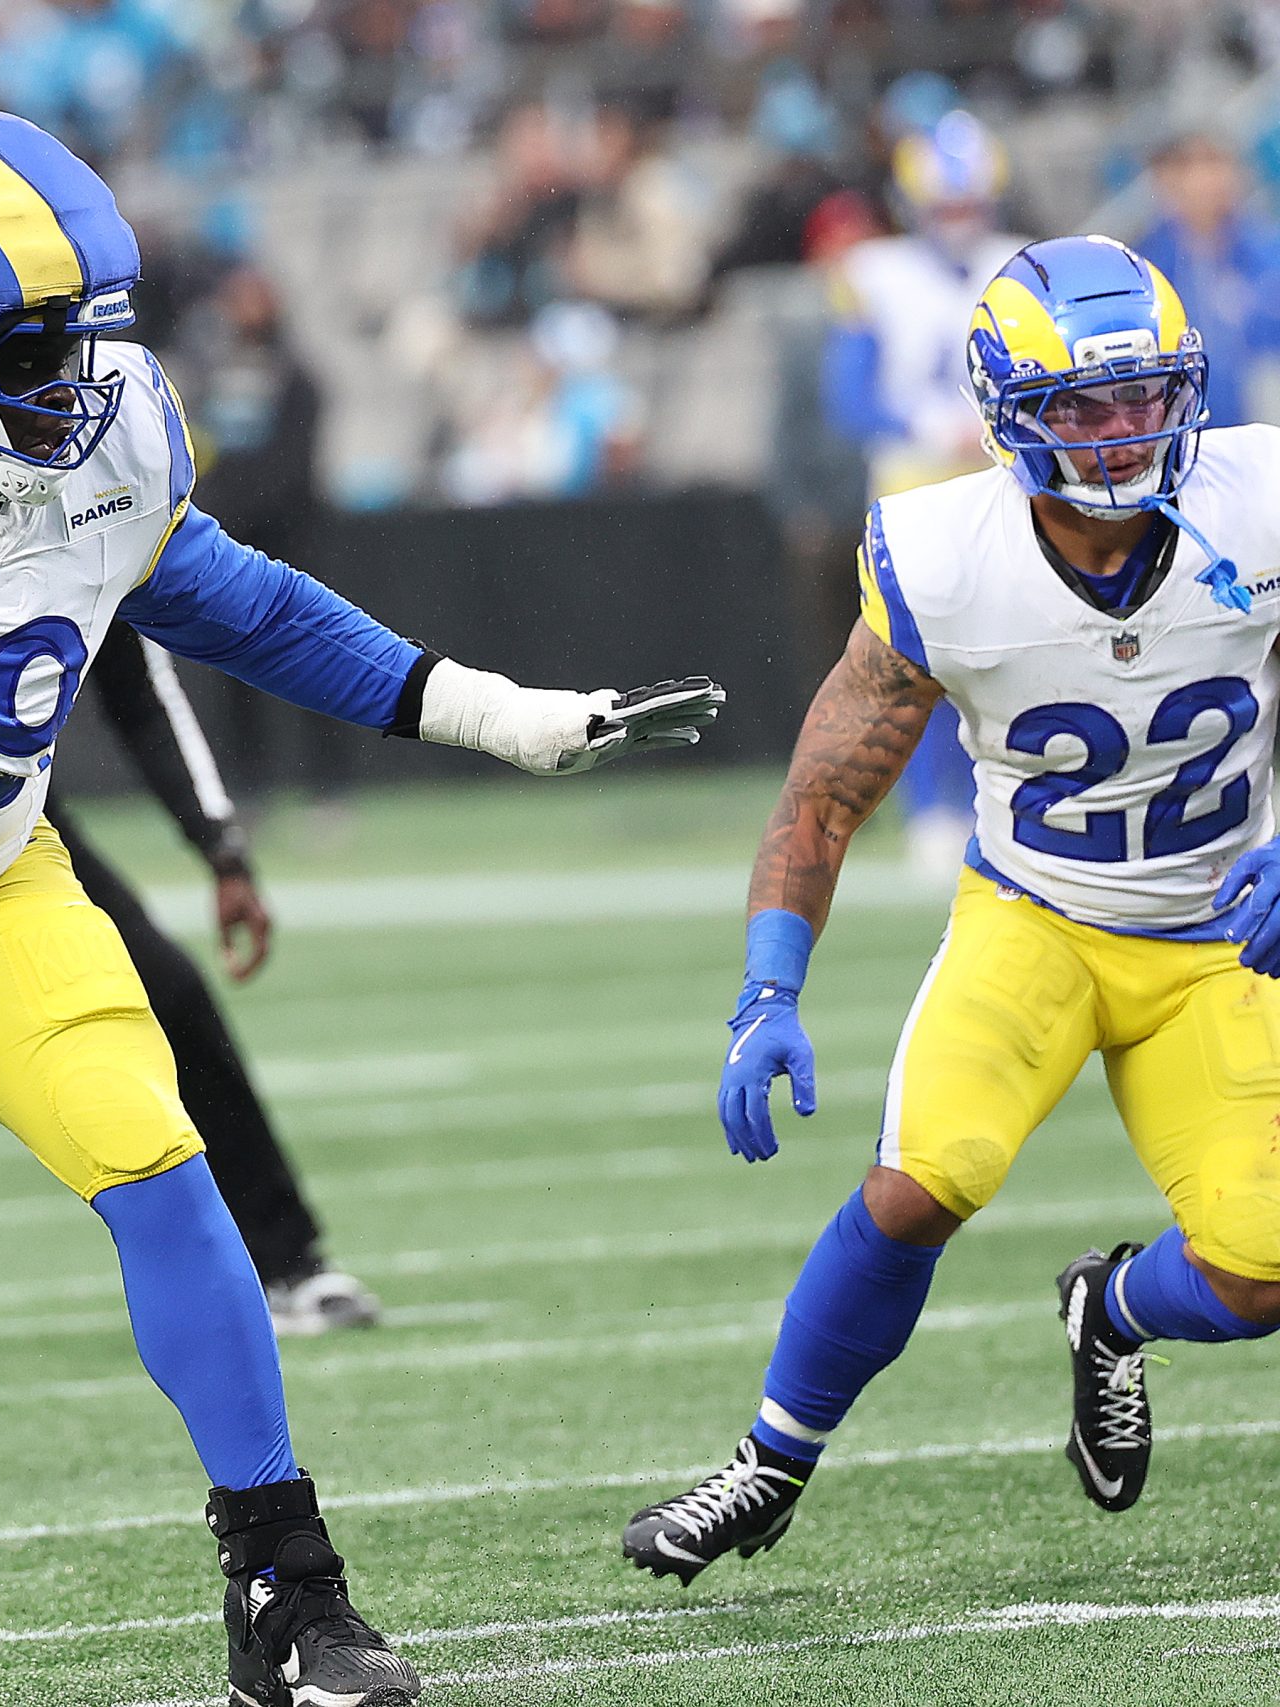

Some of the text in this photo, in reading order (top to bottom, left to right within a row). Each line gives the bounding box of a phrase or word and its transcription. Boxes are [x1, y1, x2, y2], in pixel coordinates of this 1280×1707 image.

[93, 299, 129, 317] RAMS
[70, 495, 133, 530] RAMS
[1005, 676, 1260, 863] 22
